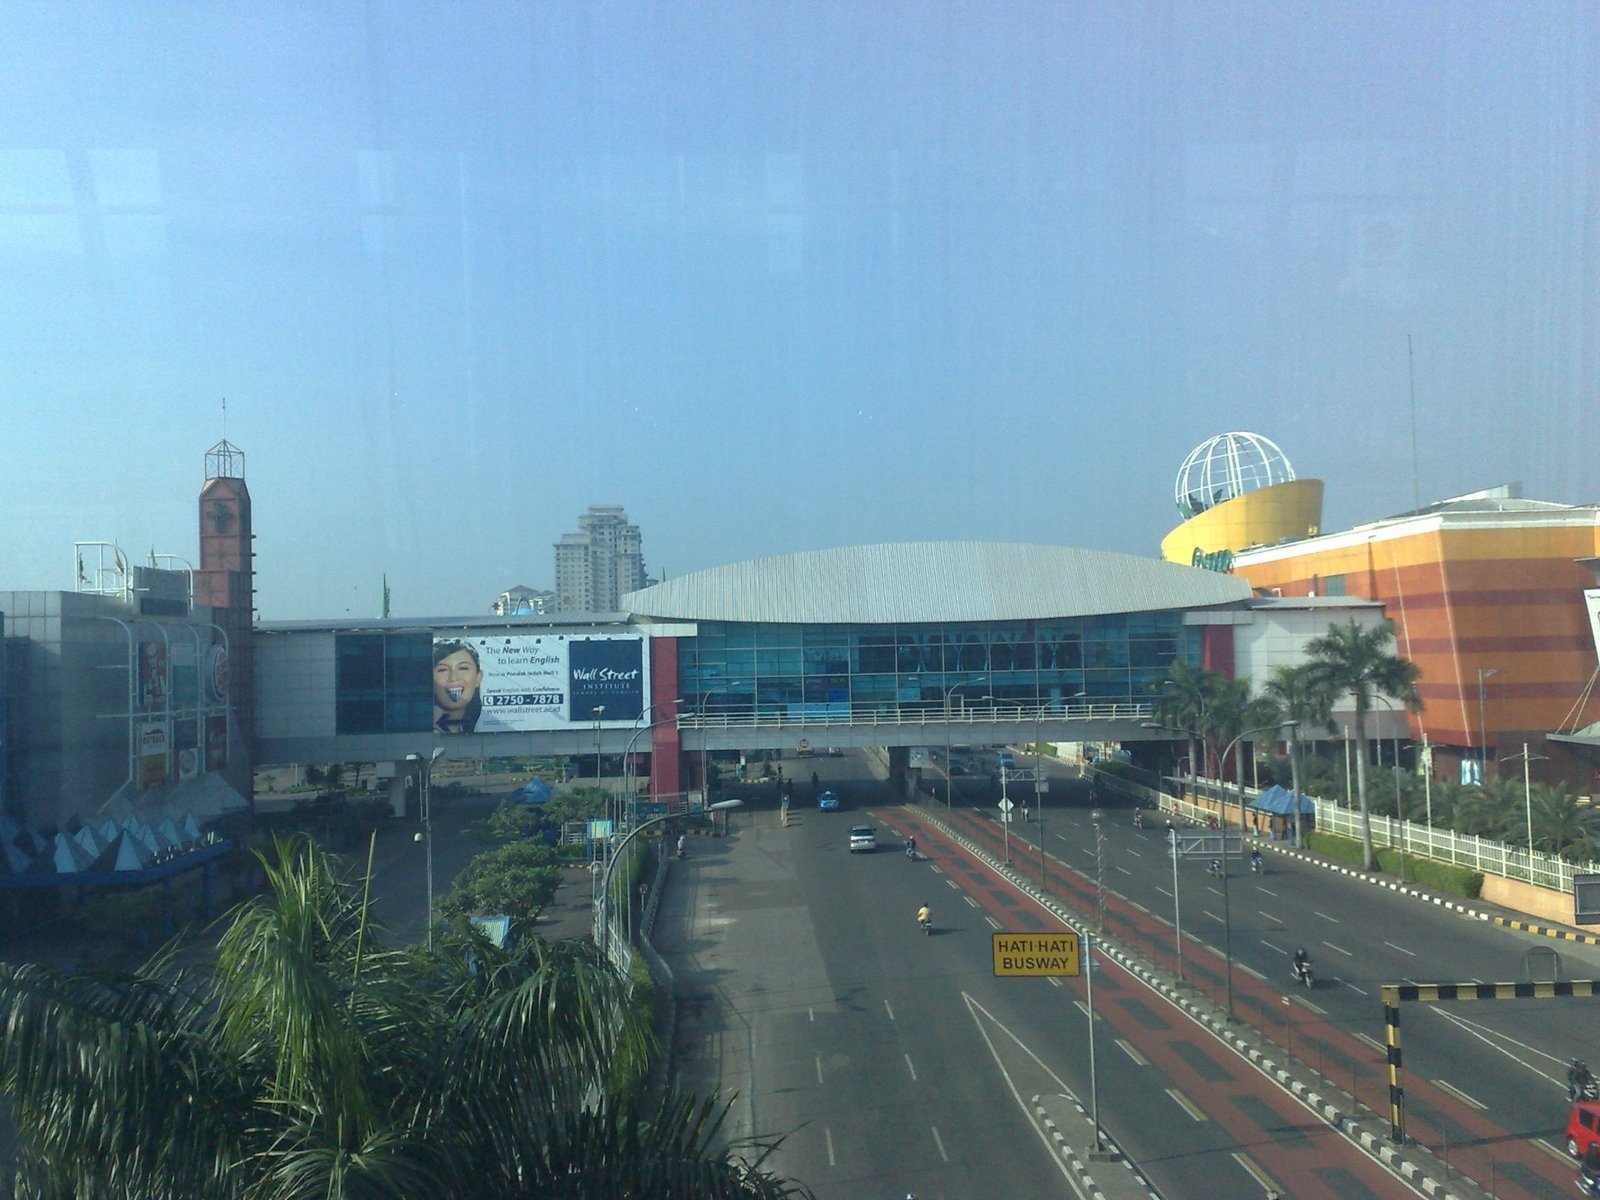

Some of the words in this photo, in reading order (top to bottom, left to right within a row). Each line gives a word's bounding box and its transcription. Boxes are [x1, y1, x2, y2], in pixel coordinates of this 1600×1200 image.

[486, 647, 501, 655] The
[502, 646, 521, 654] New
[522, 646, 539, 655] Way
[508, 656, 528, 665] learn
[530, 655, 560, 666] English
[573, 667, 598, 681] Wall
[599, 667, 639, 681] Street
[496, 695, 524, 705] 2750
[532, 694, 560, 704] 7878
[1002, 957, 1069, 969] BUSWAY
